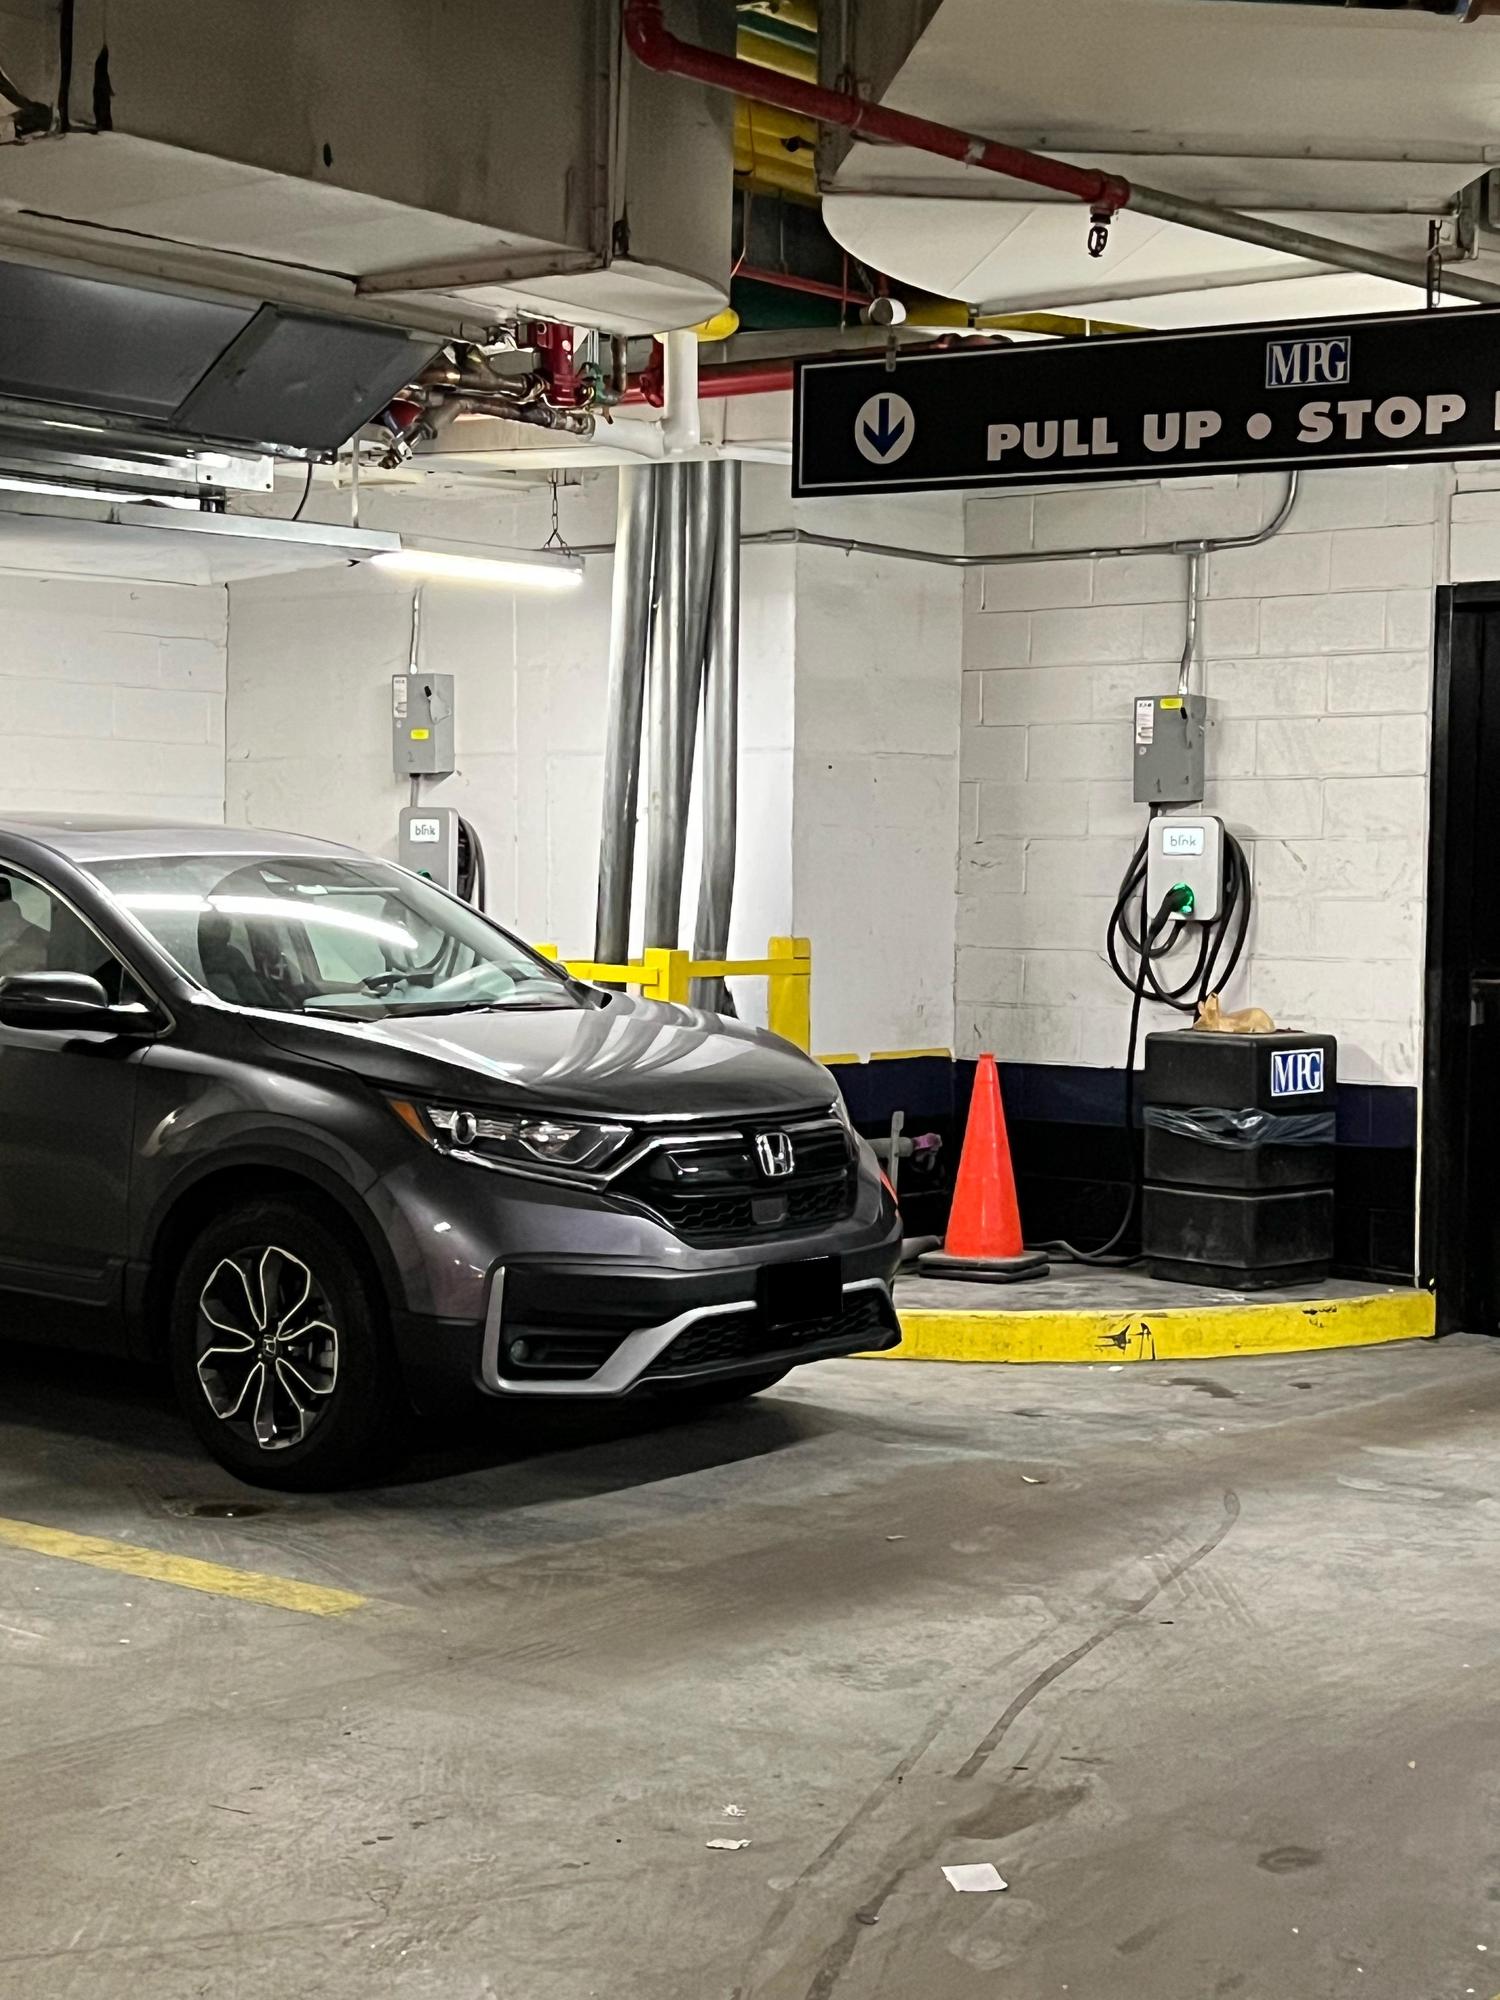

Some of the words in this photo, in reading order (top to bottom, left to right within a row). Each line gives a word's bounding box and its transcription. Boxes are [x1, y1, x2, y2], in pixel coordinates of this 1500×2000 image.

[1270, 340, 1347, 386] MPG
[986, 416, 1119, 462] PULL
[1143, 410, 1222, 452] UP
[1296, 393, 1467, 444] STOP
[414, 824, 436, 836] blink
[1170, 835, 1197, 848] blink
[1273, 1052, 1322, 1094] MPG
